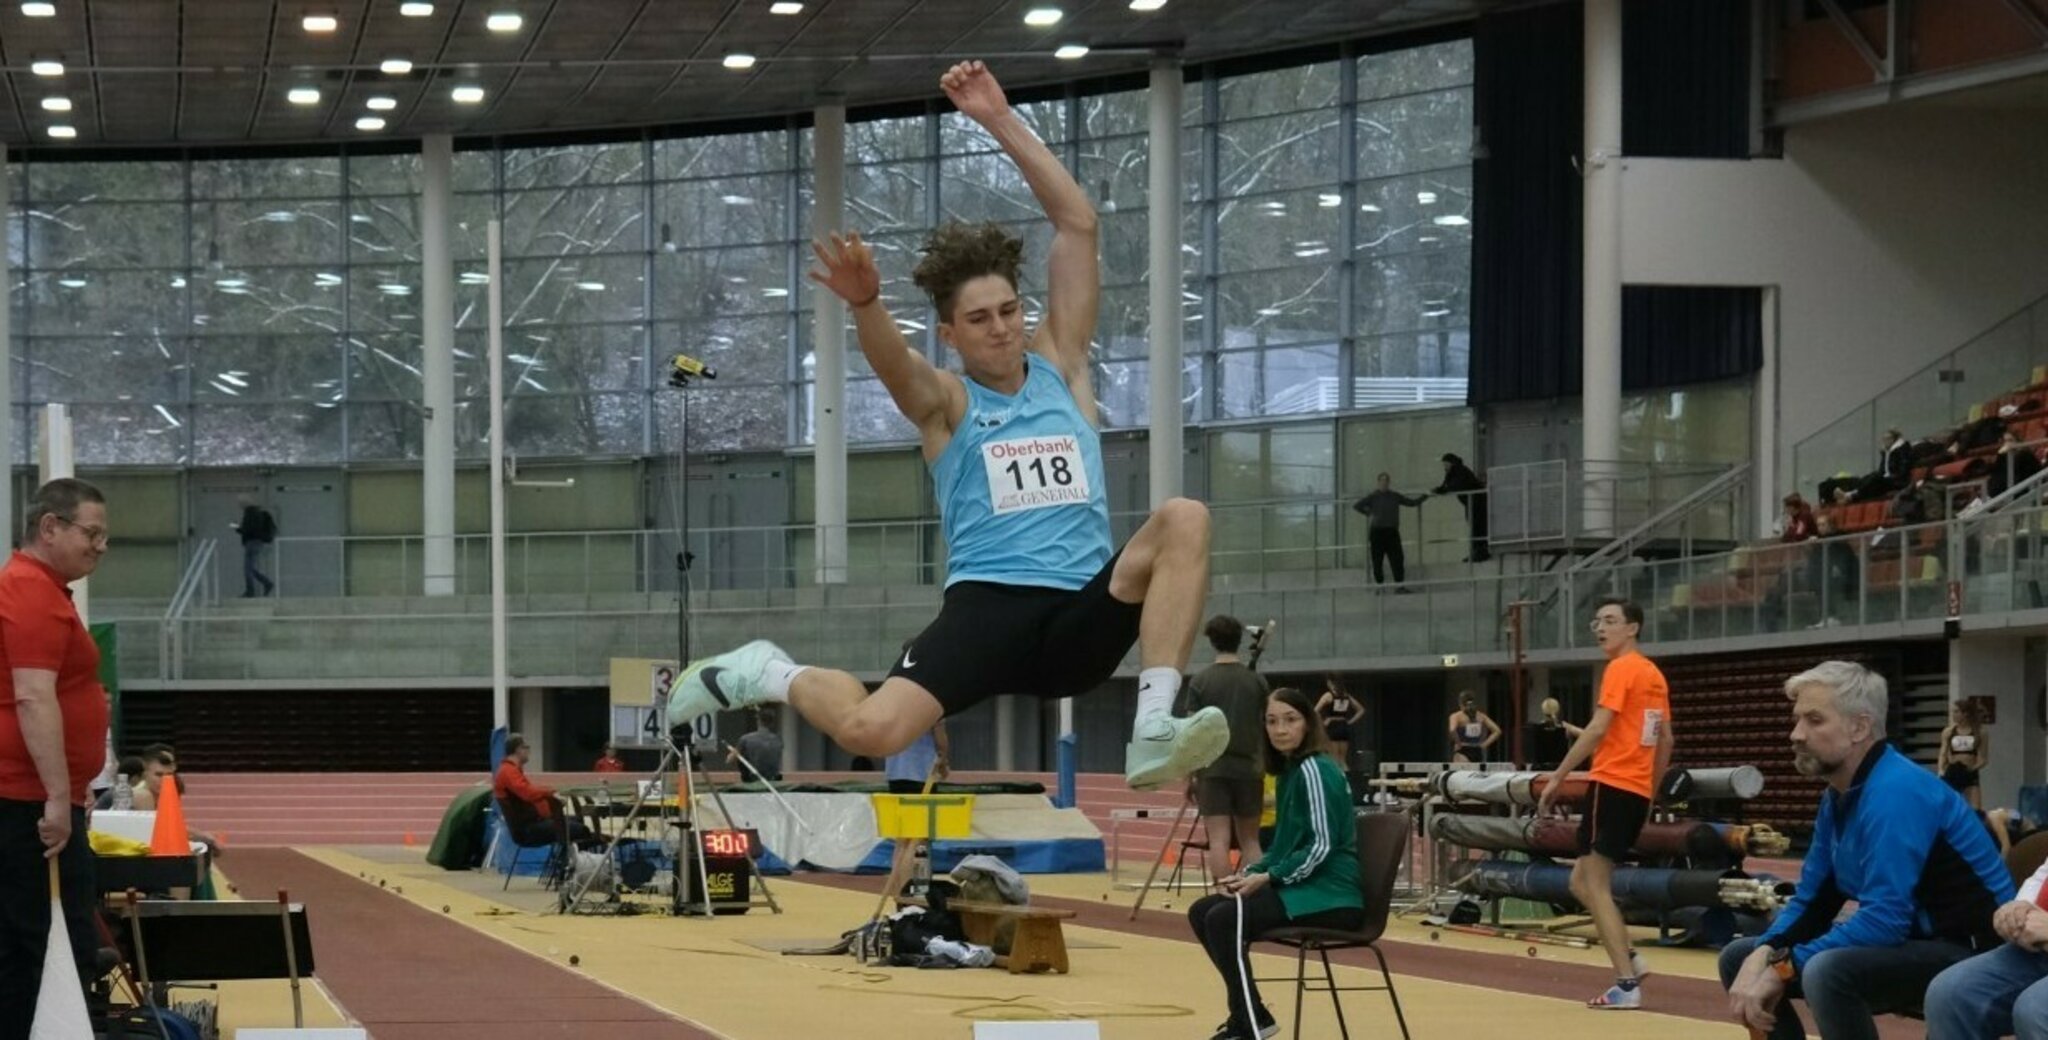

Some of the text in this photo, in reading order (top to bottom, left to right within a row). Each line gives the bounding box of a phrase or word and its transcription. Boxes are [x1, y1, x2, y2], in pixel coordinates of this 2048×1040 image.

[991, 438, 1074, 459] Oberbank
[1006, 456, 1072, 490] 118
[657, 668, 673, 696] 3
